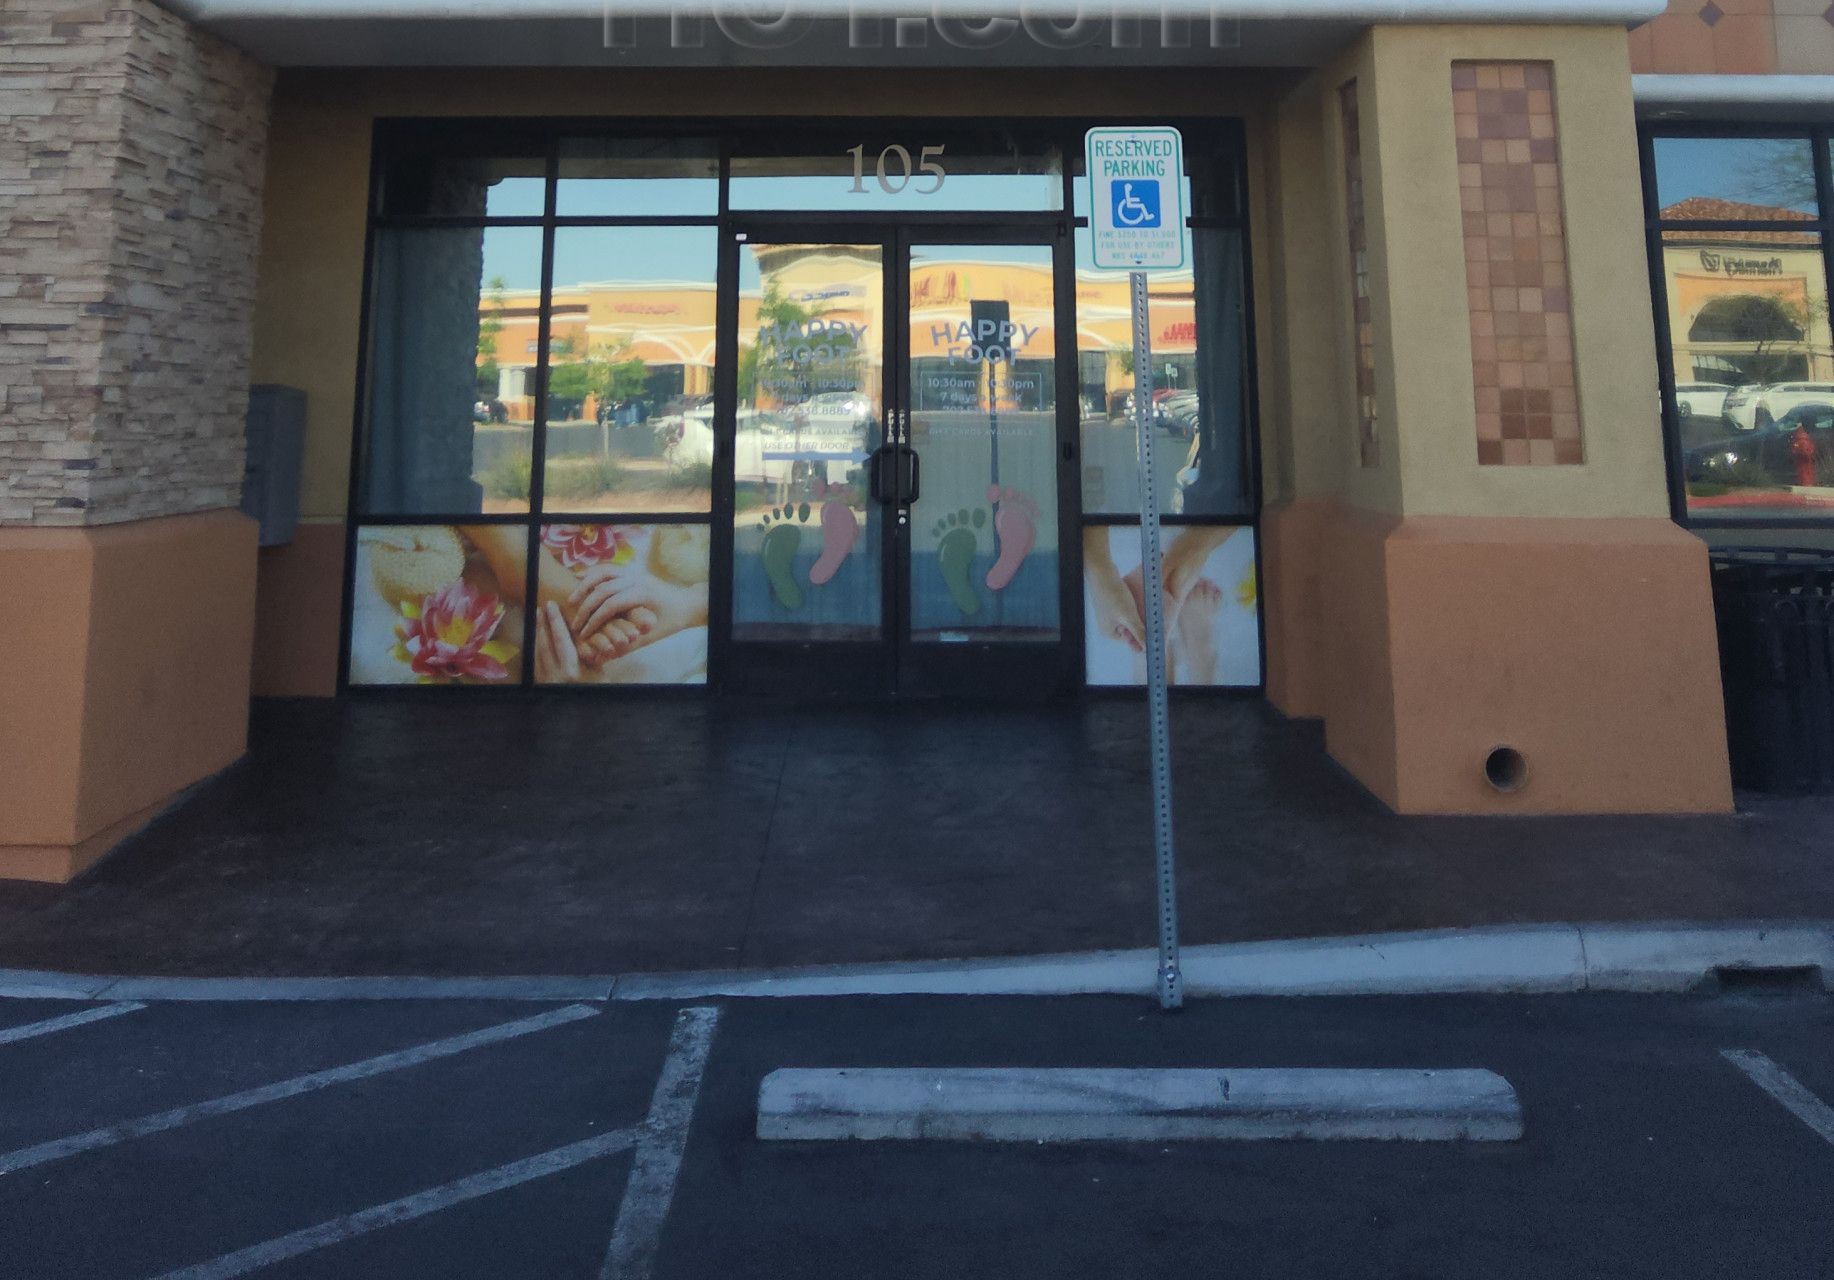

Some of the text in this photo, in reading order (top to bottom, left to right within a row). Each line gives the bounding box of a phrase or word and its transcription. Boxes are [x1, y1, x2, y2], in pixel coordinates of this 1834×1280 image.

[1095, 140, 1173, 157] RESERVED
[846, 144, 946, 194] 105
[1103, 160, 1166, 177] PARKING
[759, 319, 869, 348] HAPPY
[930, 319, 1040, 347] HAPPY
[776, 343, 851, 366] FOOT
[948, 344, 1022, 367] FOOT
[928, 377, 976, 389] 10:30am
